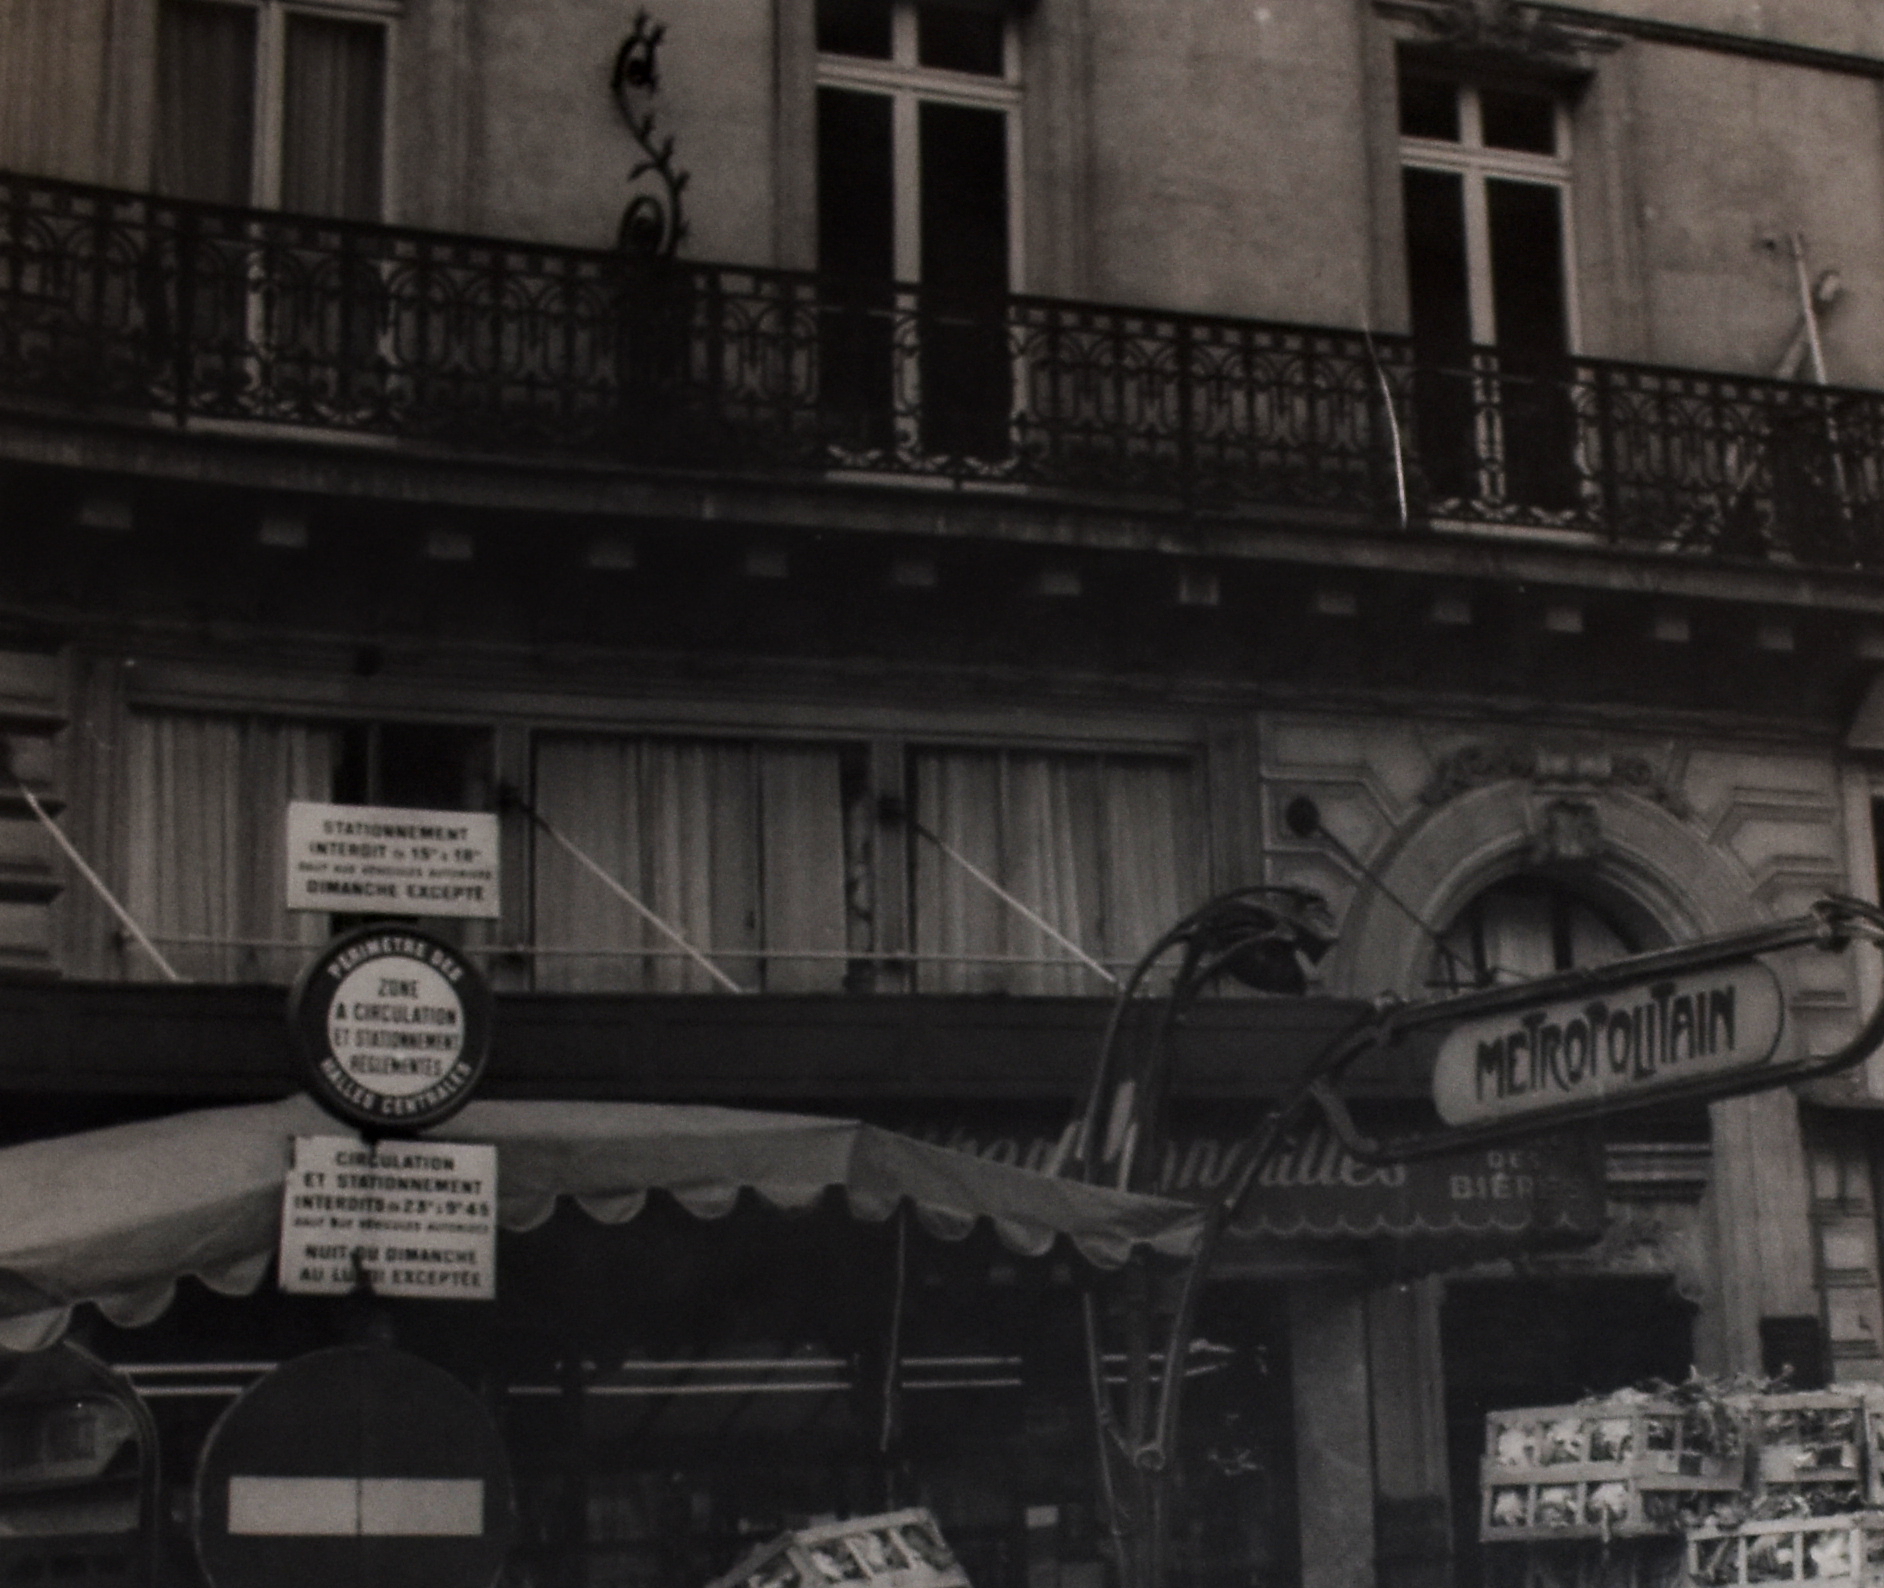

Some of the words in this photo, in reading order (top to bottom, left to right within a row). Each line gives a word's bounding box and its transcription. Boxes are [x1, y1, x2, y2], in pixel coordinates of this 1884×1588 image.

[323, 820, 468, 841] STATIONNEMENT
[309, 841, 387, 858] INTERDIT
[306, 879, 396, 898] DIMANCHE
[431, 950, 464, 983] DES
[378, 978, 419, 1000] ZONE
[353, 1002, 457, 1026] CIRCULATION
[334, 1028, 349, 1047] ET
[355, 1028, 460, 1050] STATIONNEMENT
[1475, 982, 1737, 1101] METROPOLITAIN
[320, 1057, 377, 1110] HALLES
[381, 1060, 472, 1116] CENTRALES
[336, 1151, 455, 1171] CIRCULATION
[304, 1172, 324, 1188] ET
[337, 1173, 482, 1195] STATIONNEMENT
[295, 1195, 385, 1213] INTERDITS
[306, 1245, 347, 1260] NUIT
[385, 1247, 476, 1265] DIMANCHE
[301, 1267, 323, 1281] AU
